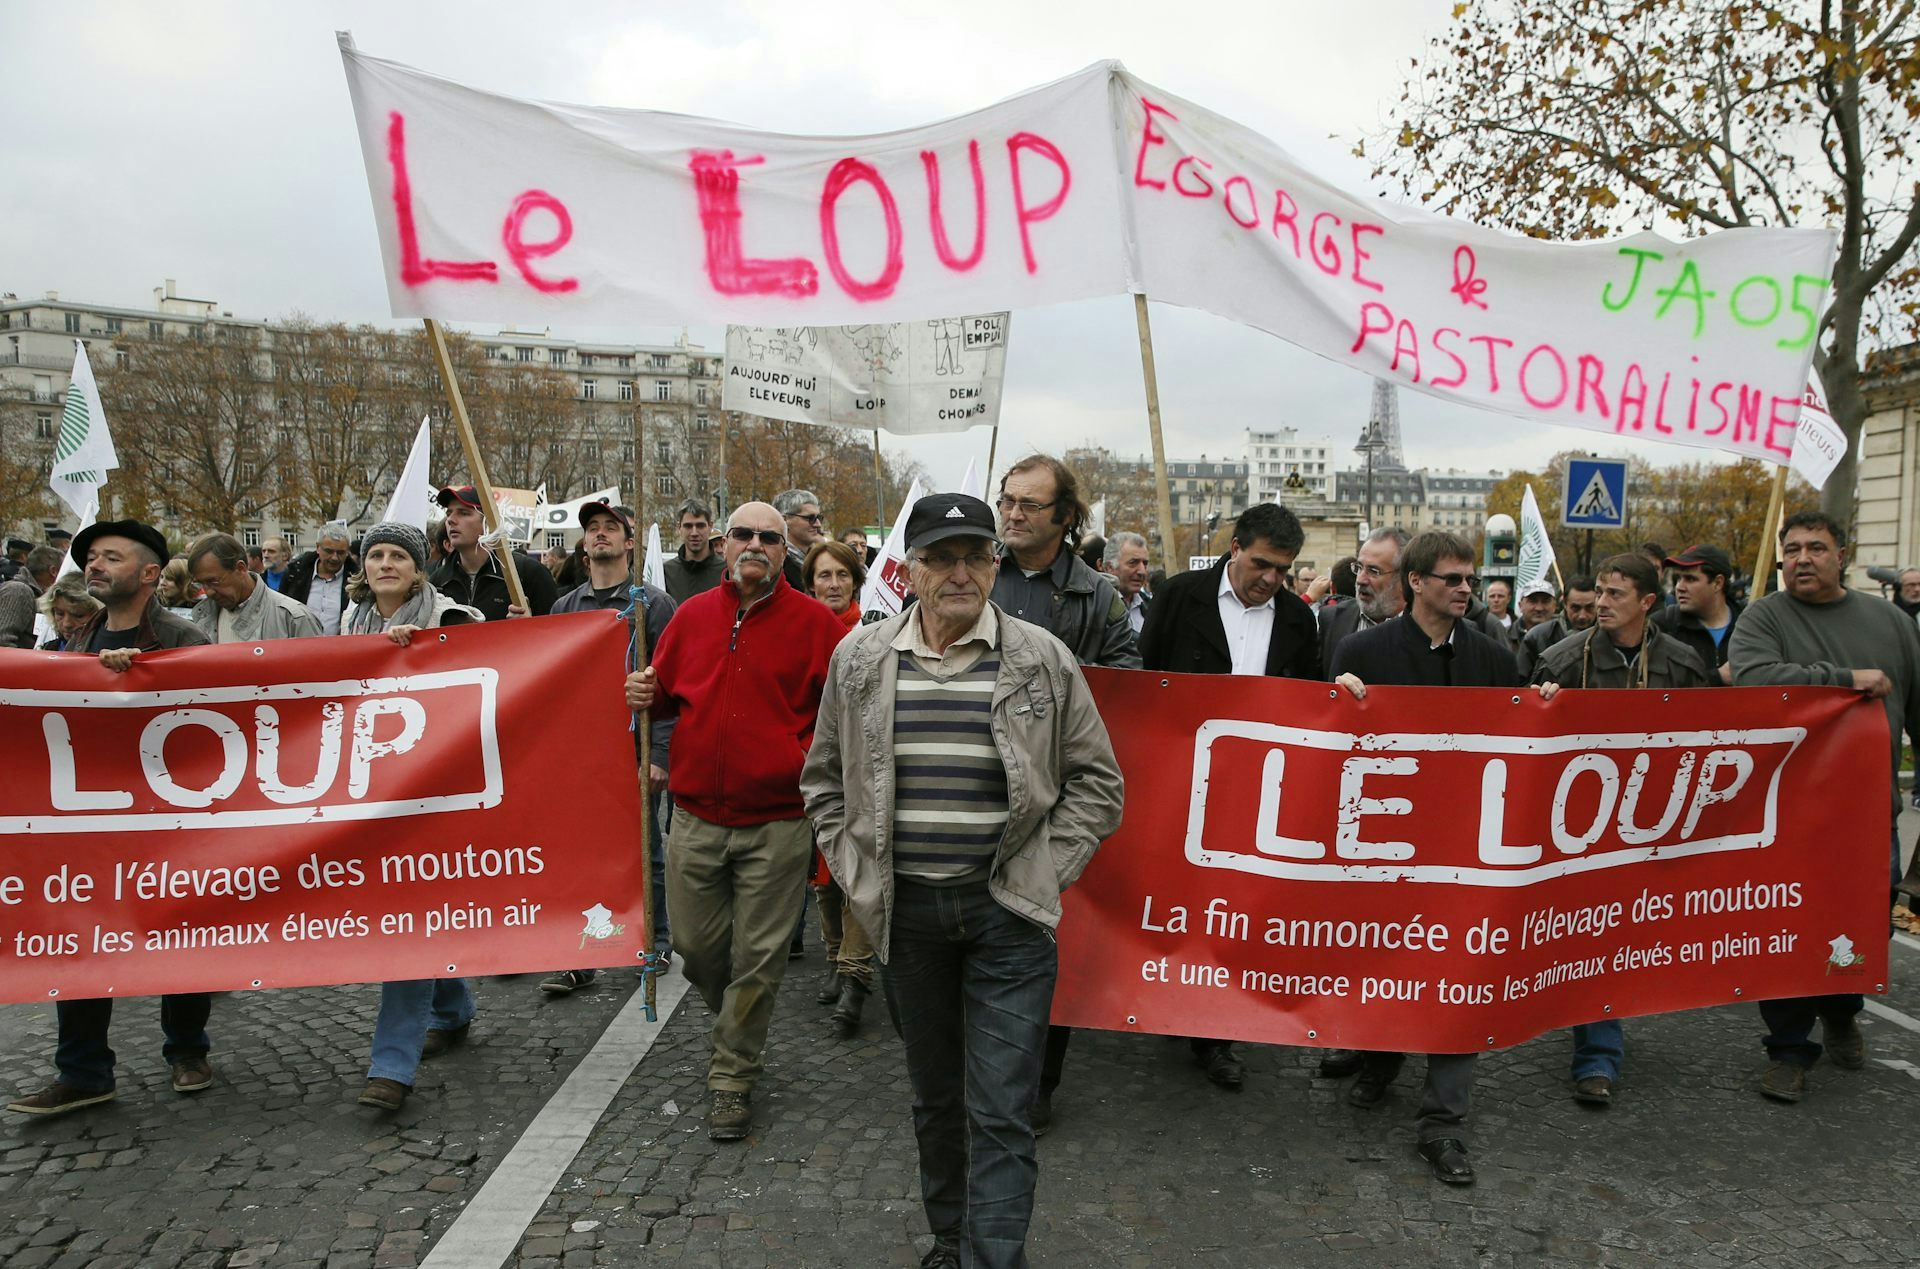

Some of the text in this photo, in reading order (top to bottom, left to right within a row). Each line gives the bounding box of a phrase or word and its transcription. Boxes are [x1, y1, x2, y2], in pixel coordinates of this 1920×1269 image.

[387, 110, 1074, 305] Le LOUP
[1133, 95, 1386, 293] EGORGE
[749, 386, 812, 410] ELEVEURS
[41, 698, 427, 811] LOUP
[1255, 747, 1754, 865] LE LOUP
[43, 864, 94, 904] de
[114, 857, 280, 902] l'élevage
[297, 853, 365, 889] des
[381, 844, 545, 885] moutons
[13, 897, 542, 957] tous les animaux élevés en plein air
[1141, 879, 1802, 955] La fin annoncée de l'élevage des moutons
[1141, 928, 1798, 1005] et une menace pour tous les animaux élevés en plein air
